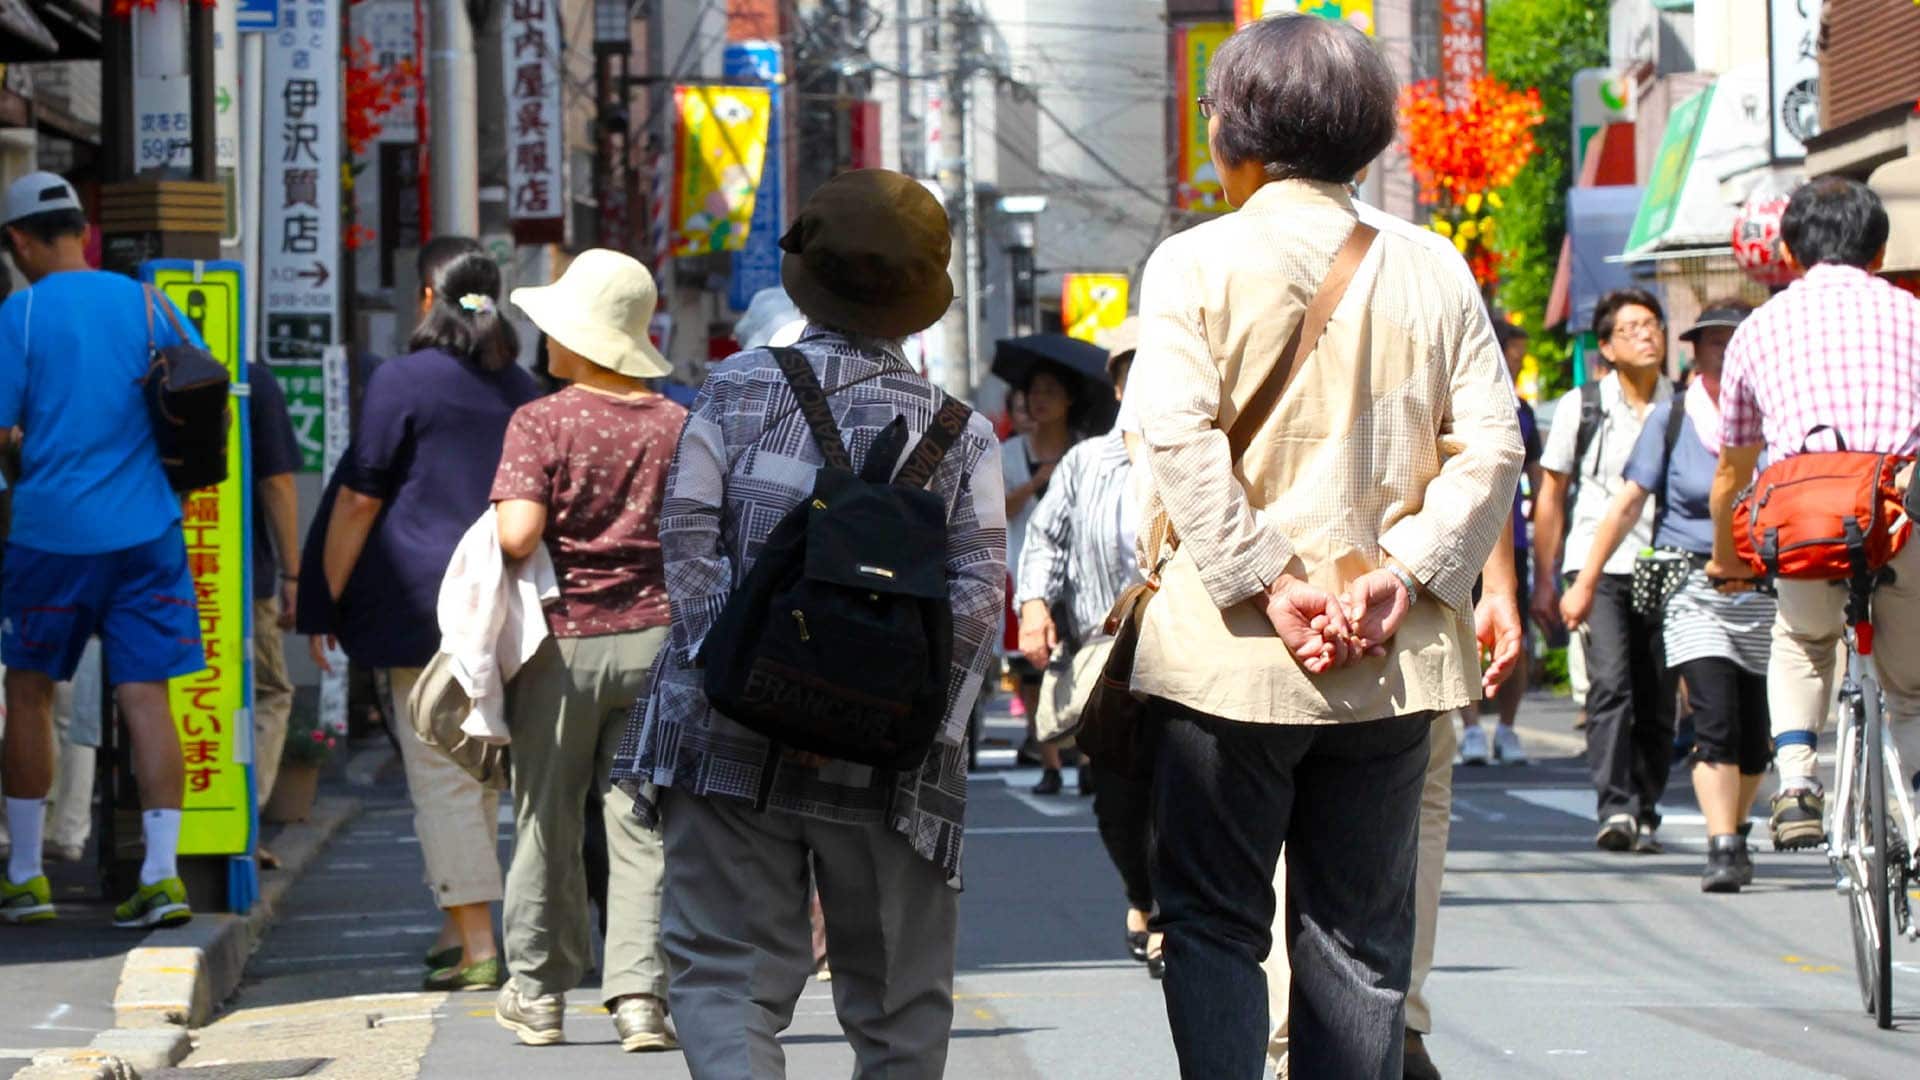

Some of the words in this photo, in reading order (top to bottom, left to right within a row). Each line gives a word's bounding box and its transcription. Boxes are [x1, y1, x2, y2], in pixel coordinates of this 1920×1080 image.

[282, 78, 319, 253] 伊沢質店
[513, 0, 550, 212] 山内屋呉服店
[183, 484, 221, 792] 幅工事を行なっています
